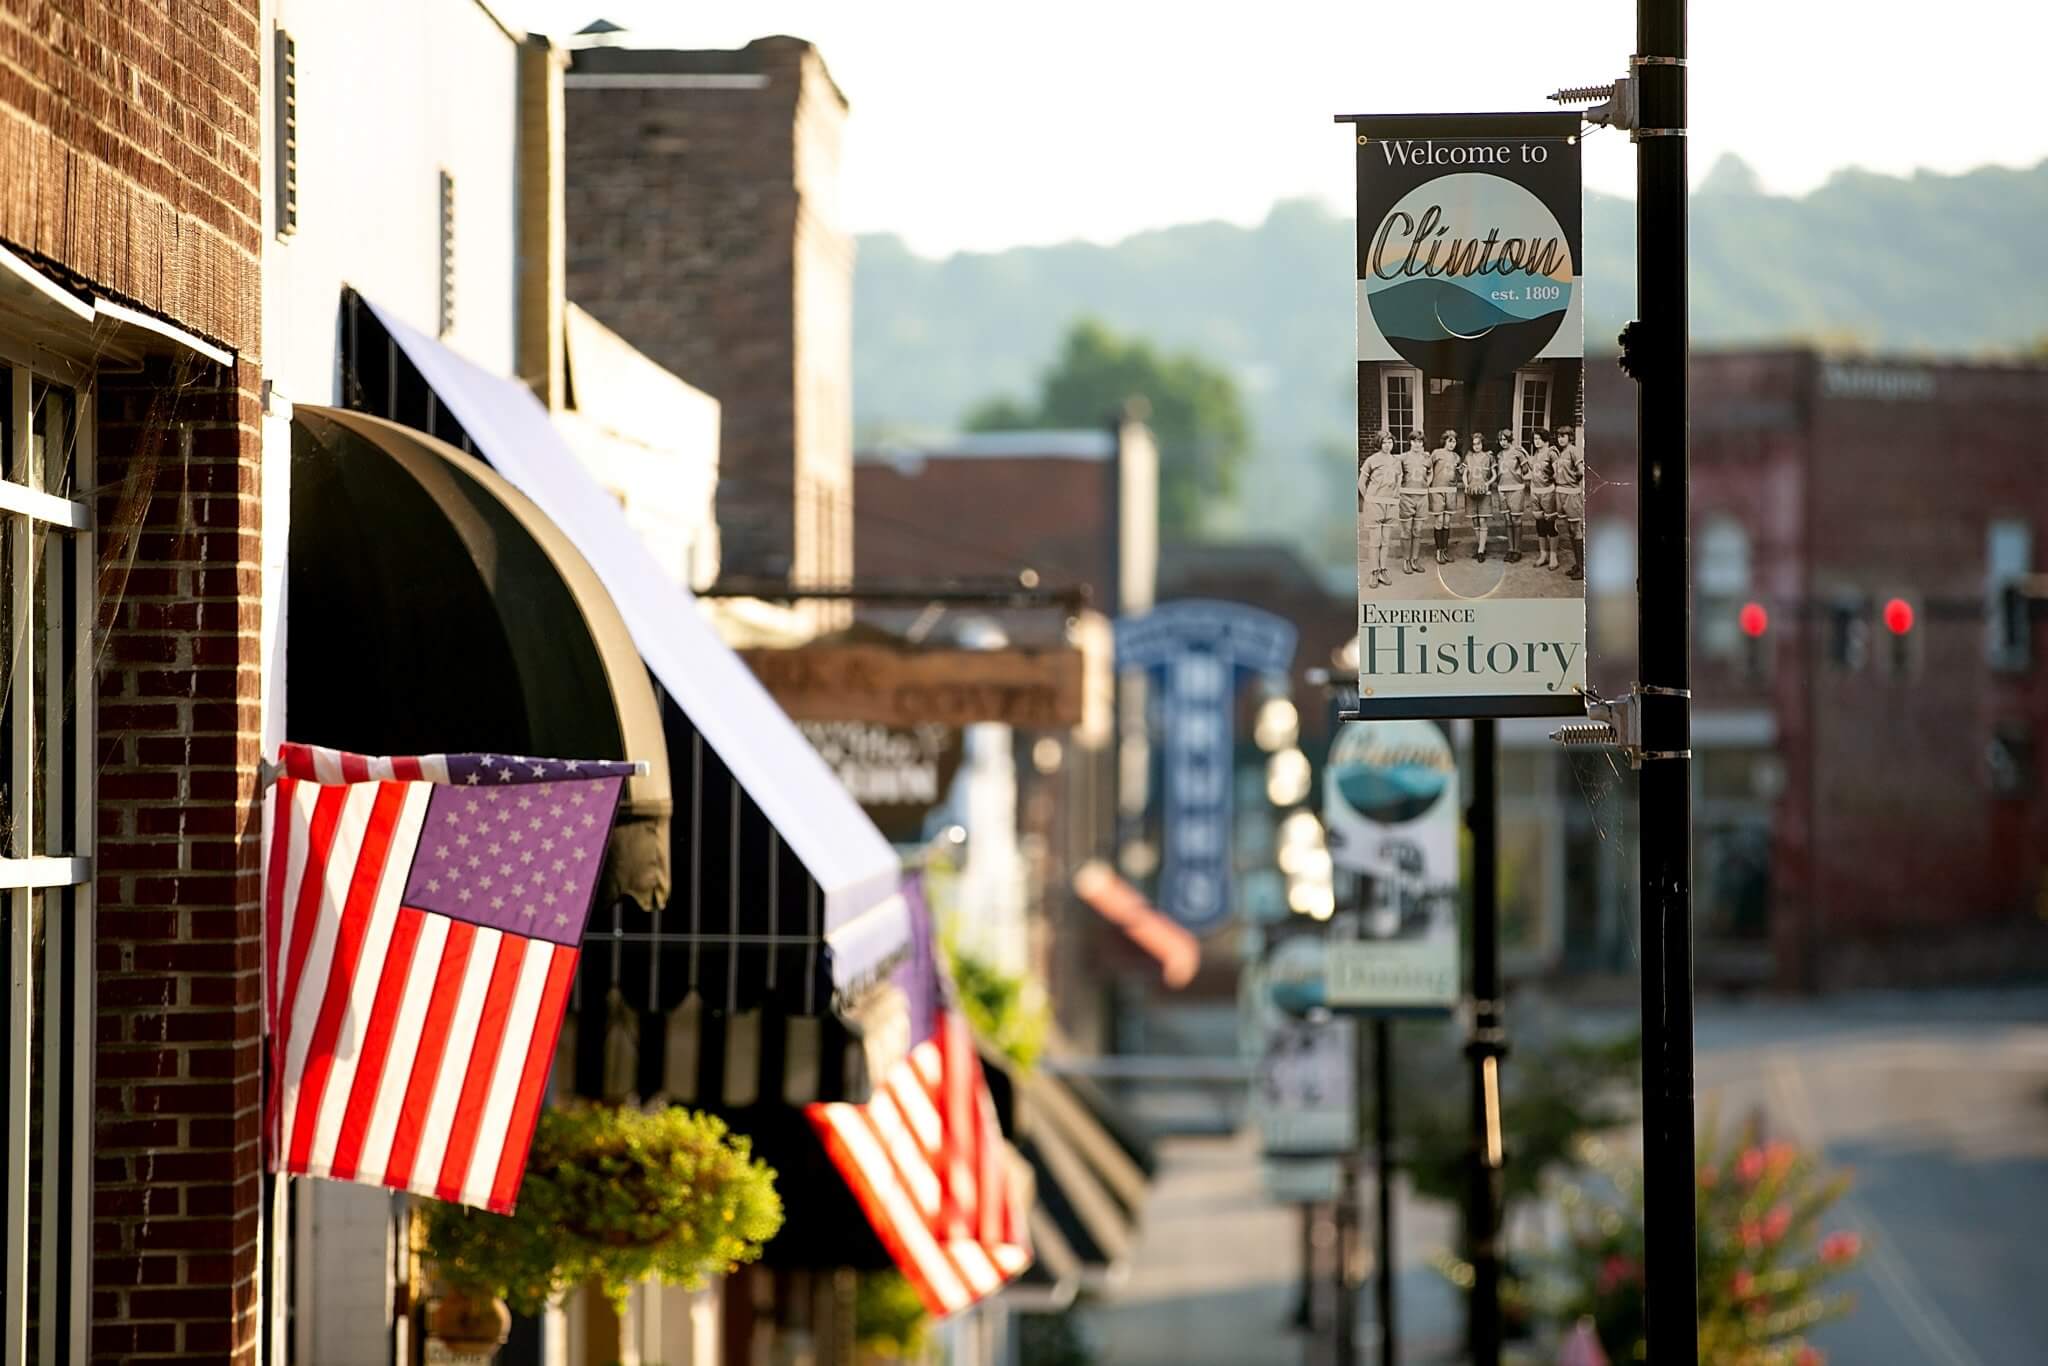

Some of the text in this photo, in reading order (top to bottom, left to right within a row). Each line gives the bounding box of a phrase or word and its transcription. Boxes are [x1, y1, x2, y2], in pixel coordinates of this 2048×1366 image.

[1380, 140, 1548, 165] Welcome to
[1372, 205, 1565, 280] Clinton
[1491, 286, 1560, 300] est. 1809
[1362, 604, 1475, 623] EXPERIENCE
[1361, 625, 1581, 691] History
